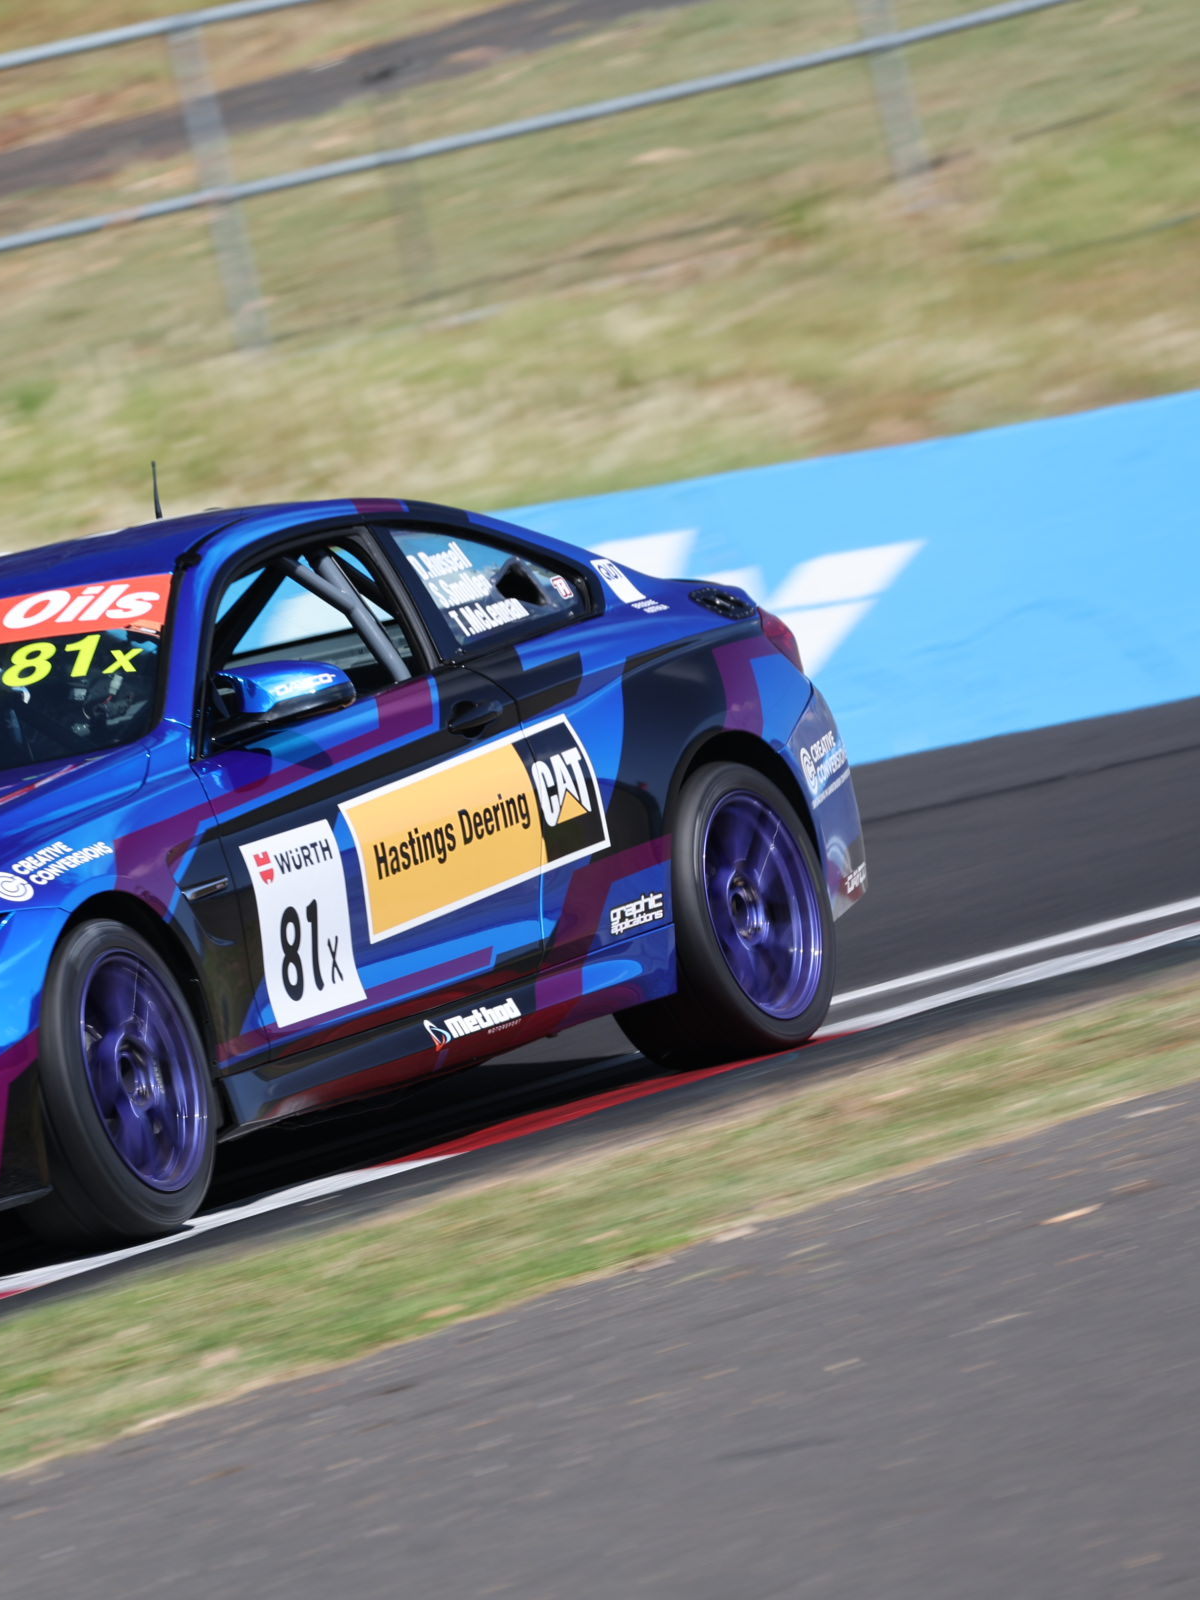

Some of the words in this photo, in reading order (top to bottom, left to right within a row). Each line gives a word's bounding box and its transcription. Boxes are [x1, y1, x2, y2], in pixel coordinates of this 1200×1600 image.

[2, 584, 161, 630] Oils
[530, 747, 592, 827] CAT
[11, 841, 73, 875] CREATIVE
[373, 818, 457, 881] Hastings
[457, 793, 531, 846] Deering
[29, 841, 114, 885] CONVERSIONS
